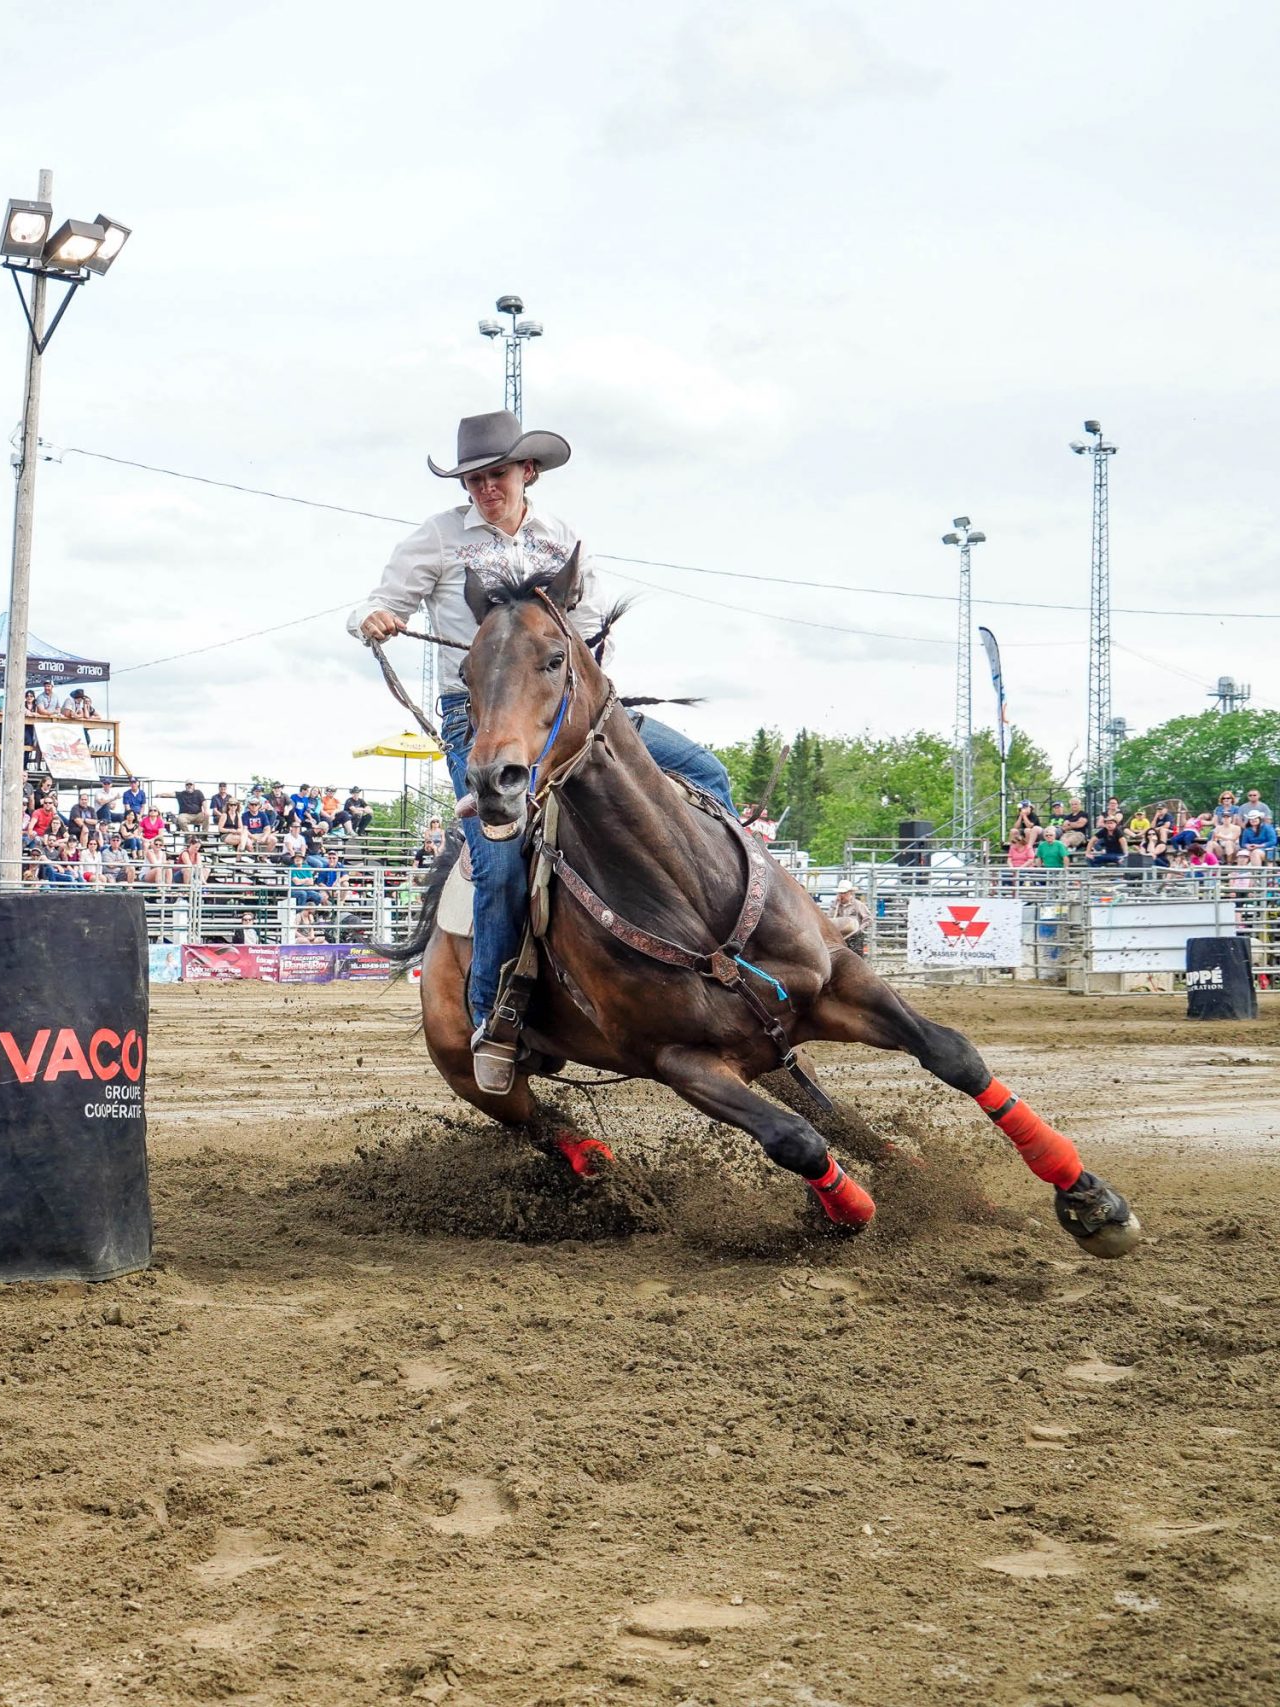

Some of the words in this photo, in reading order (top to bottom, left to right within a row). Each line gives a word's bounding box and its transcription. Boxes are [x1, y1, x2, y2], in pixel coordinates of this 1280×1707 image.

[37, 660, 65, 673] amaro
[76, 664, 103, 677] amaro
[105, 1084, 142, 1100] GROUPE
[84, 1100, 142, 1119] COOPÉRATIF
